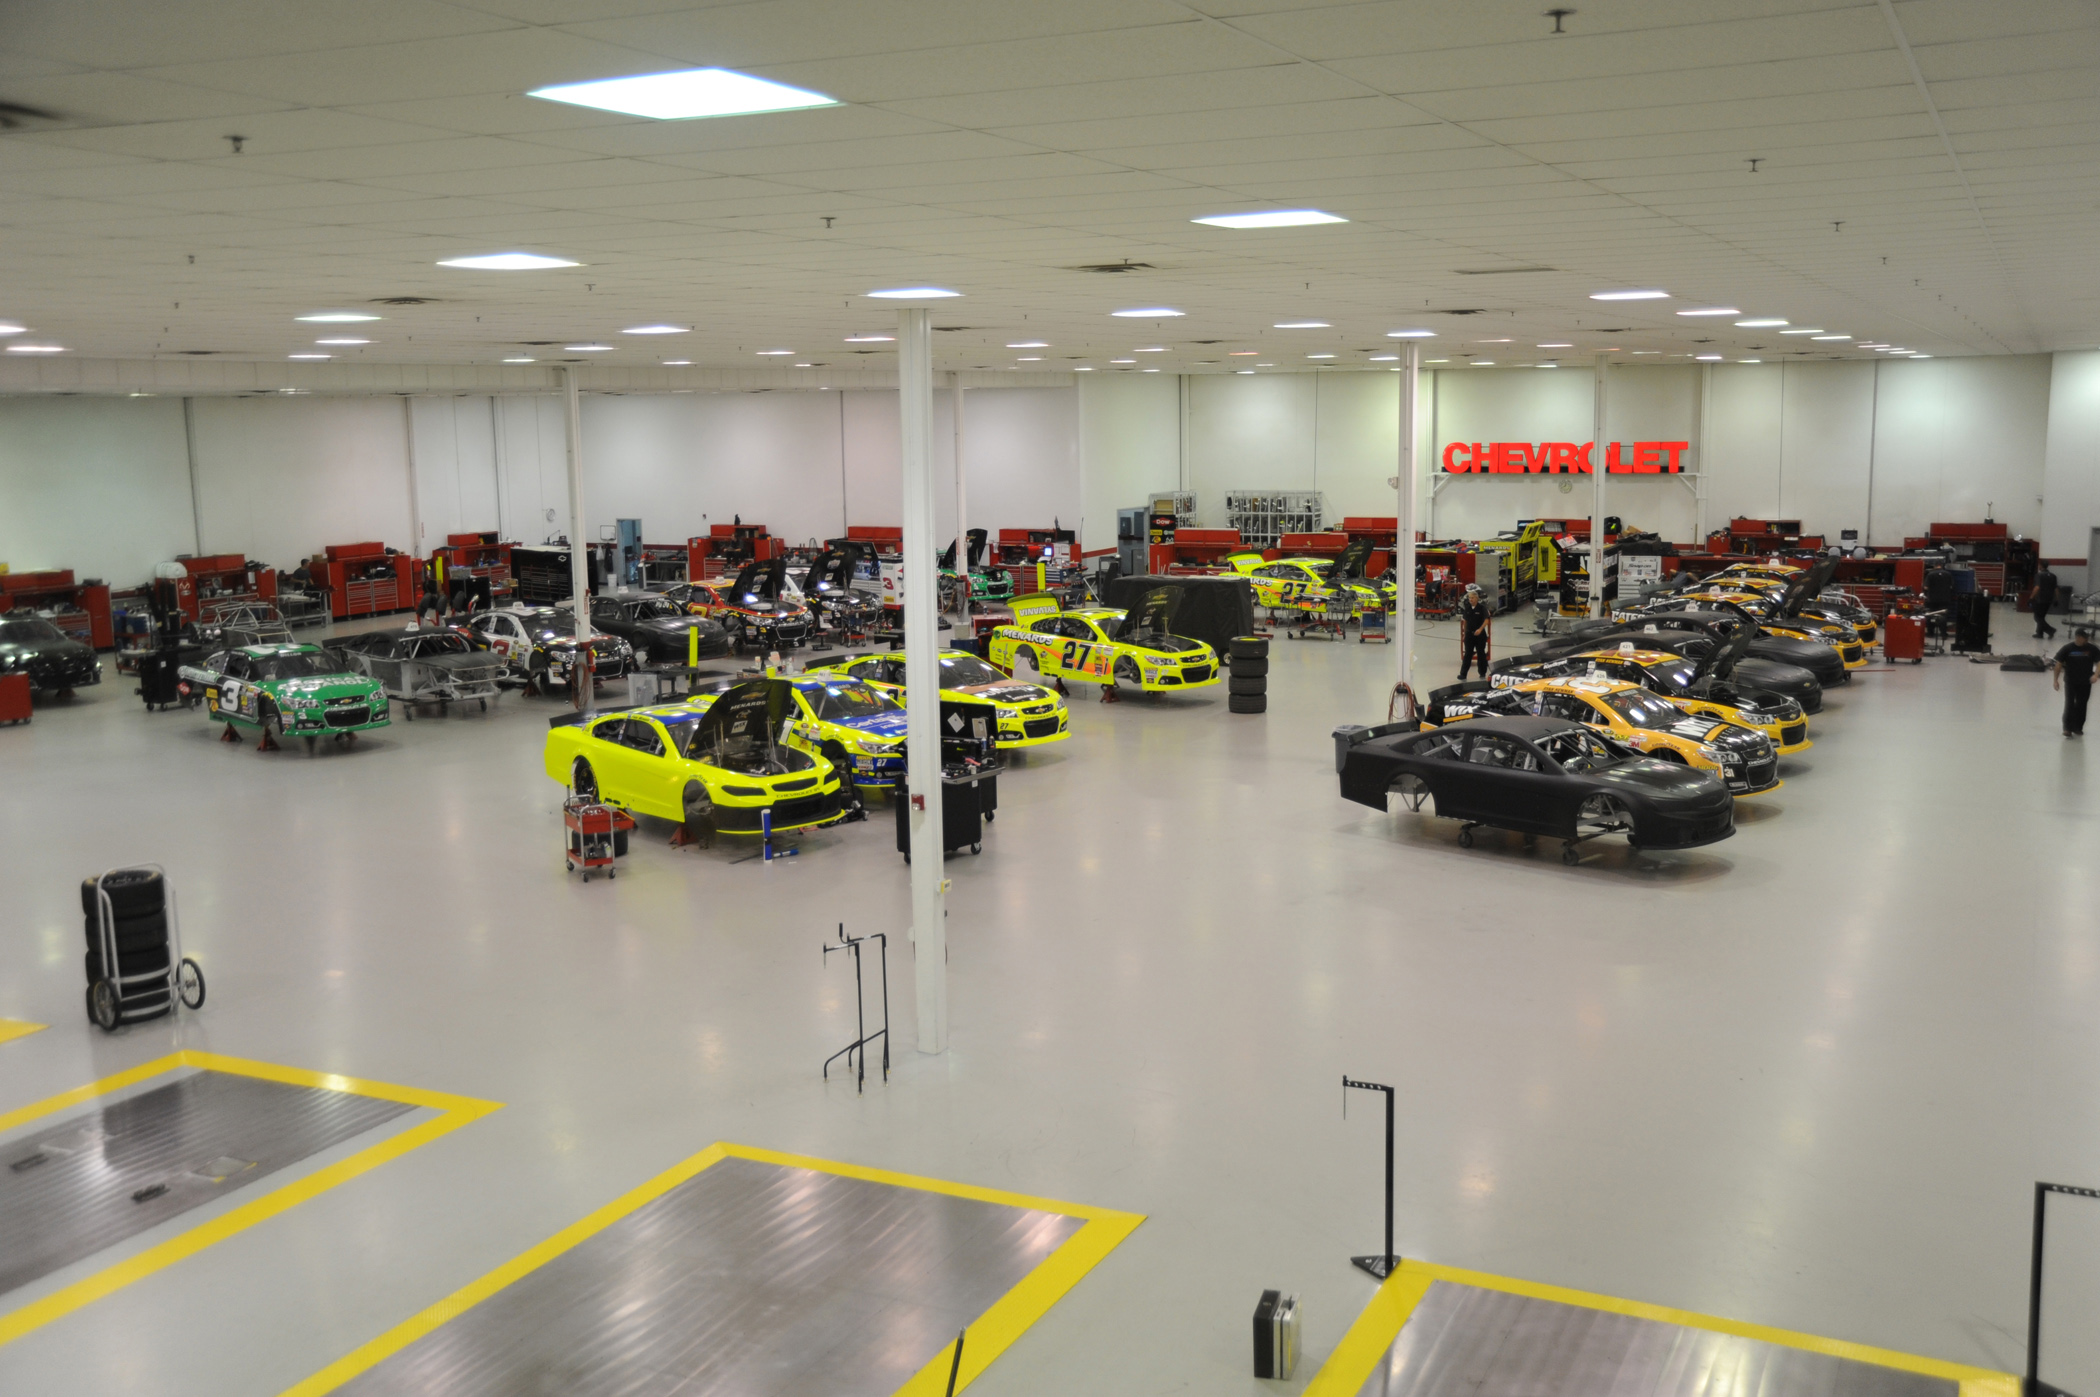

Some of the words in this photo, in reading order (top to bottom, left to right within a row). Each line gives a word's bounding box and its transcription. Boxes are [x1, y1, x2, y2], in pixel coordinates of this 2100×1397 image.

[1442, 441, 1688, 474] CHEVROLET
[883, 577, 894, 590] 3
[1019, 605, 1056, 617] SYLVANIA
[1002, 629, 1053, 646] MENARDS
[1060, 640, 1092, 671] 27
[221, 680, 240, 712] 3
[730, 701, 766, 710] MENARDS
[1444, 704, 1479, 717] WIX
[1000, 722, 1009, 730] 27
[877, 758, 887, 767] 27
